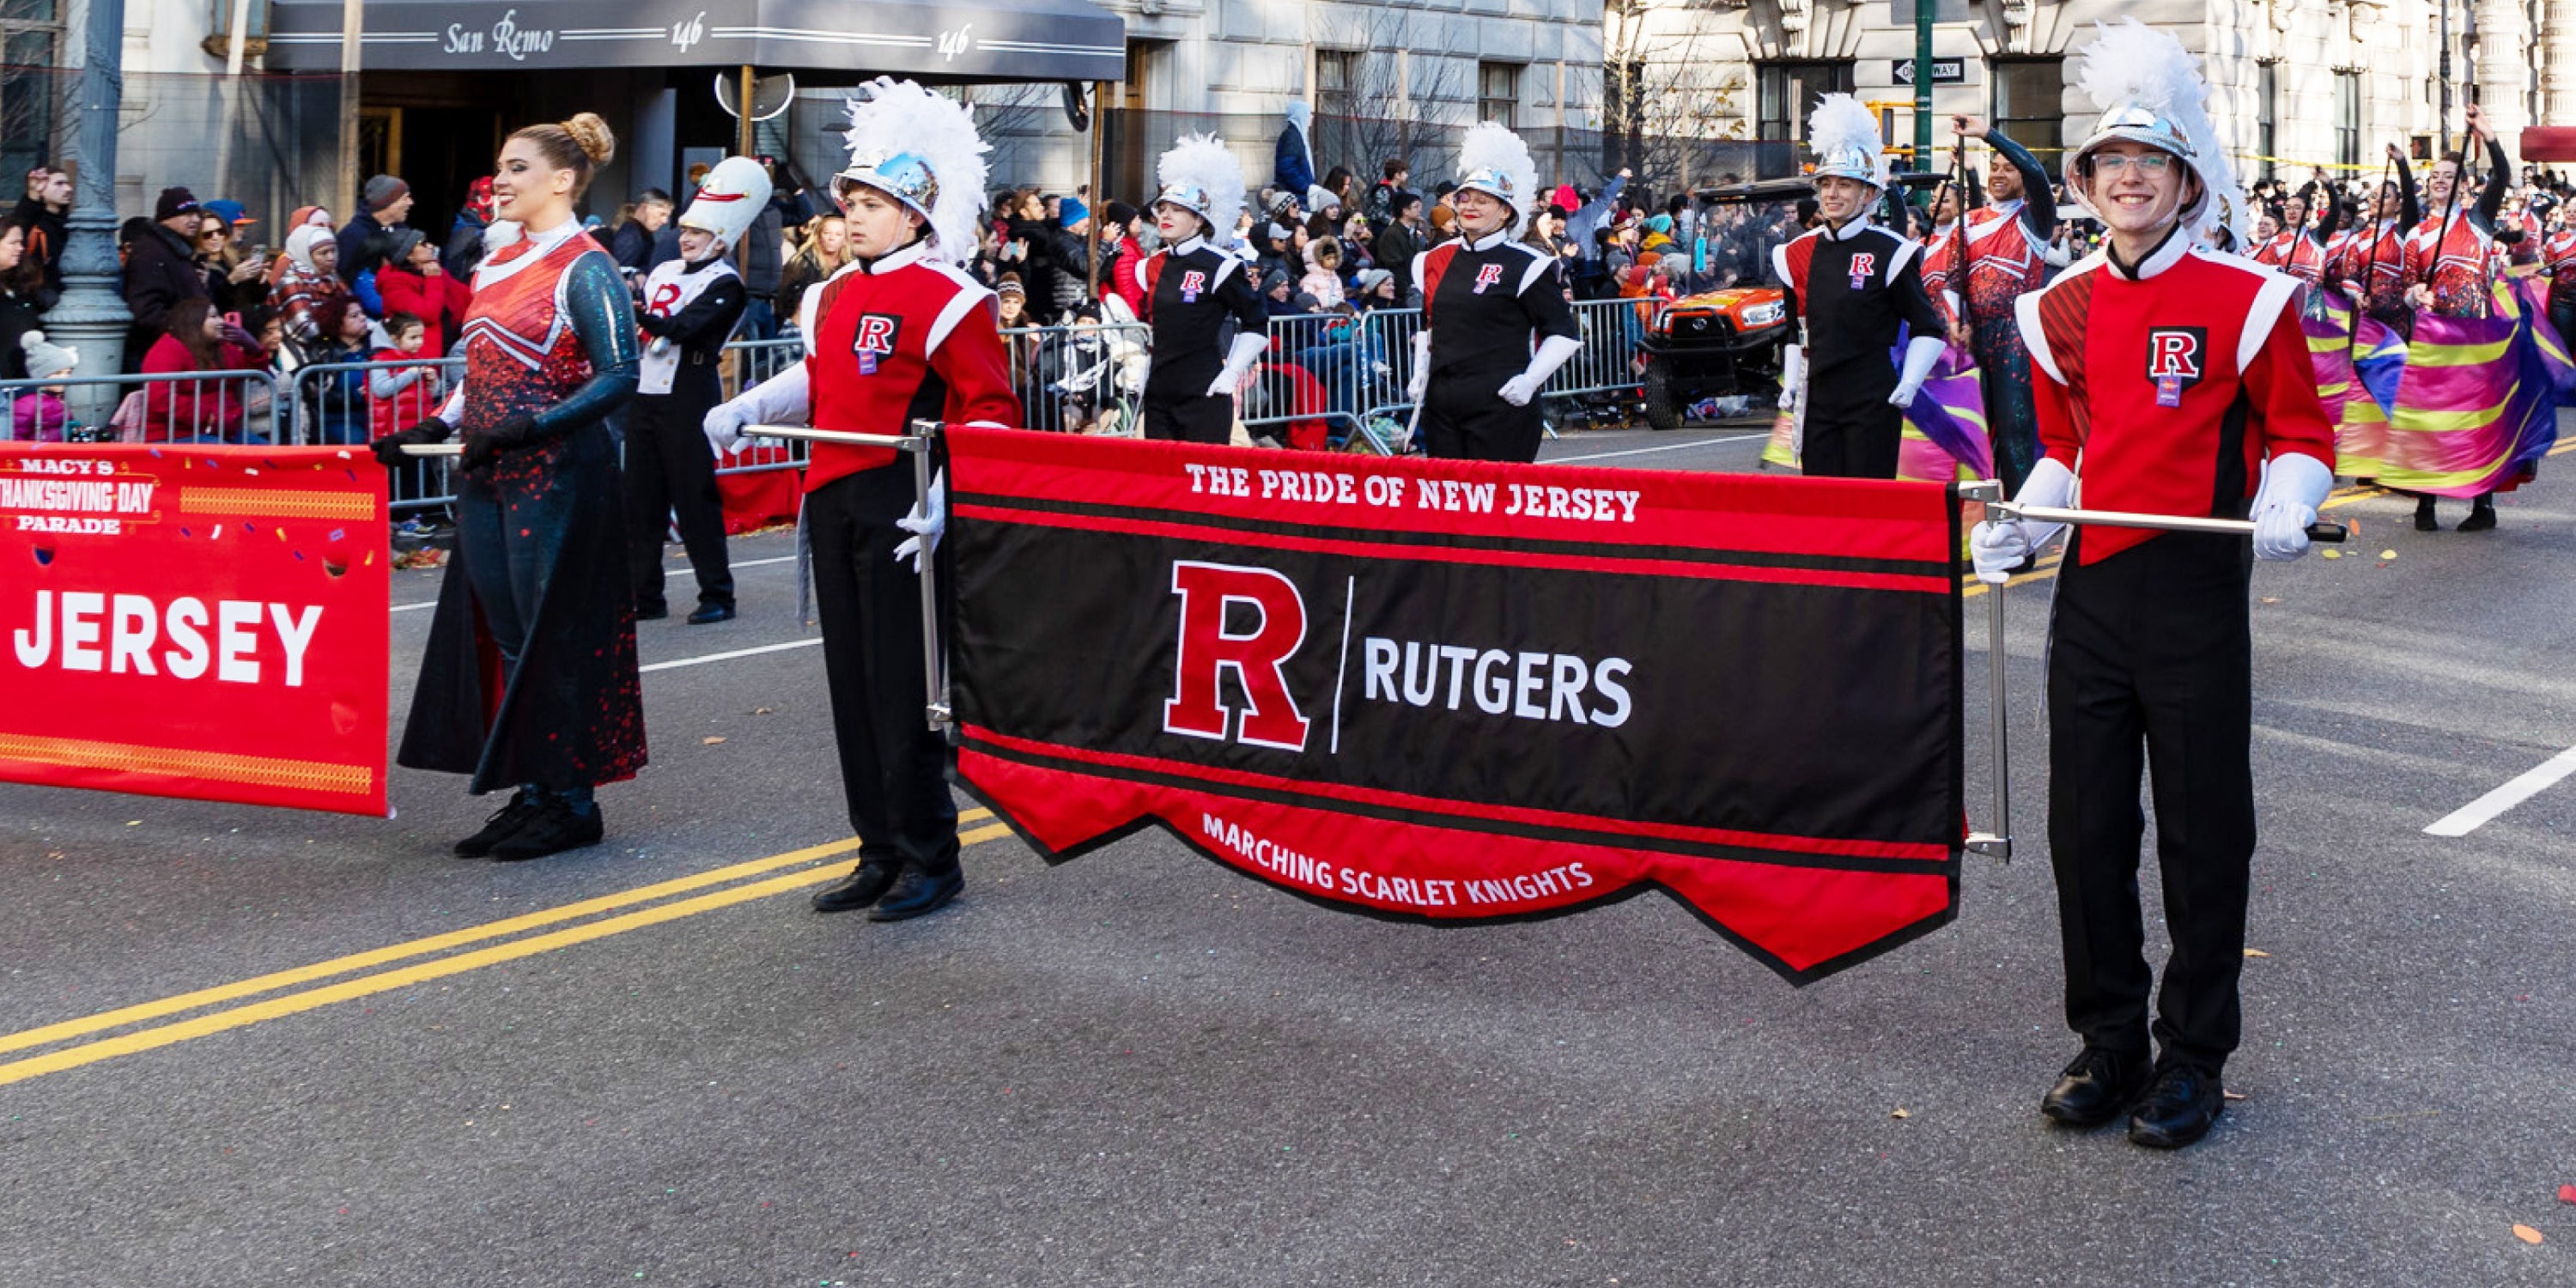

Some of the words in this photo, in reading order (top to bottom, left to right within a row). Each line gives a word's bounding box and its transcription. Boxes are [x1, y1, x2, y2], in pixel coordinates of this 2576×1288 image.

[443, 23, 484, 53] San
[492, 9, 554, 61] Remo
[671, 11, 706, 52] 146
[938, 23, 972, 62] 146
[1180, 270, 1206, 293] R
[1475, 263, 1503, 284] R
[1849, 252, 1874, 276] R
[854, 315, 894, 354] R
[2149, 331, 2198, 378] R
[117, 483, 154, 513] DAY
[1185, 464, 1249, 497] THE
[1259, 469, 1357, 504] PRIDE
[1364, 475, 1404, 507] OF
[1417, 478, 1496, 514] NEW
[1504, 483, 1640, 523] JERSEY
[17, 515, 121, 535] PARADE
[14, 589, 324, 687] JERSEY
[1163, 560, 1309, 752] R
[1365, 637, 1633, 728] RUTGERS
[1203, 813, 1334, 889] MARCHING
[1340, 867, 1458, 907] SCARLET
[1463, 861, 1594, 905] KNIGHTS
